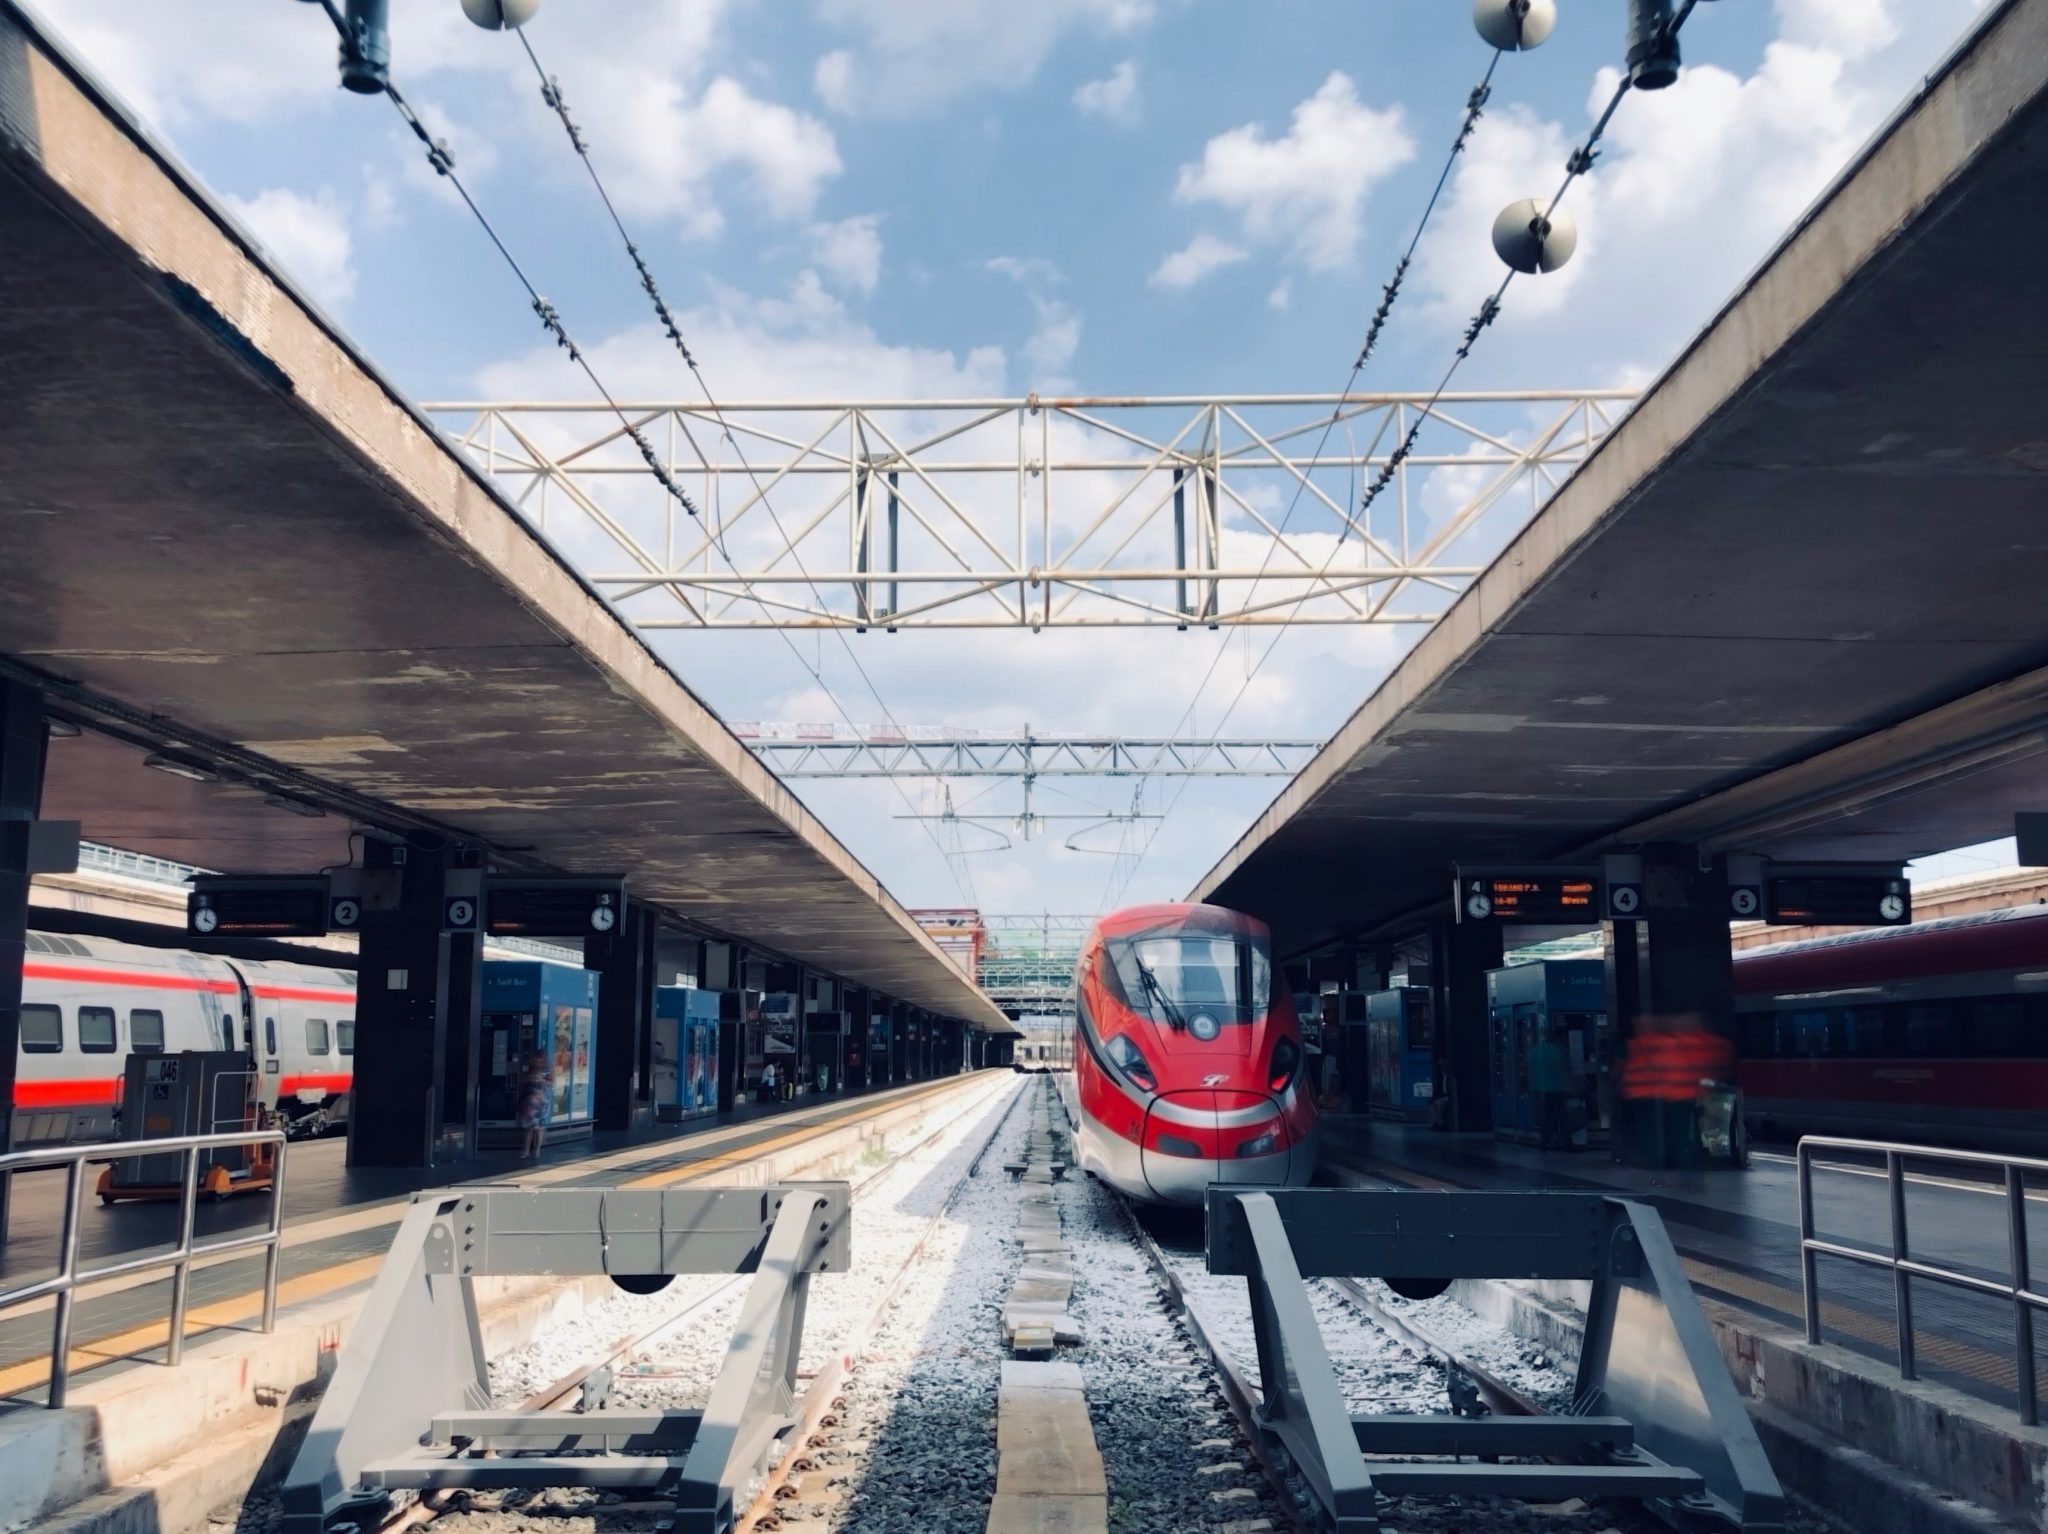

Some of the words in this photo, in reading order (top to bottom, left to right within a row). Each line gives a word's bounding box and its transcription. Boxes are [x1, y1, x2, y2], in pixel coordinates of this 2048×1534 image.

[601, 894, 610, 905] 3
[1620, 893, 1631, 905] 4
[1739, 895, 1749, 908] 5
[341, 906, 351, 919] 2
[456, 906, 465, 919] 3
[513, 978, 527, 986] Bar
[161, 1061, 177, 1082] 046
